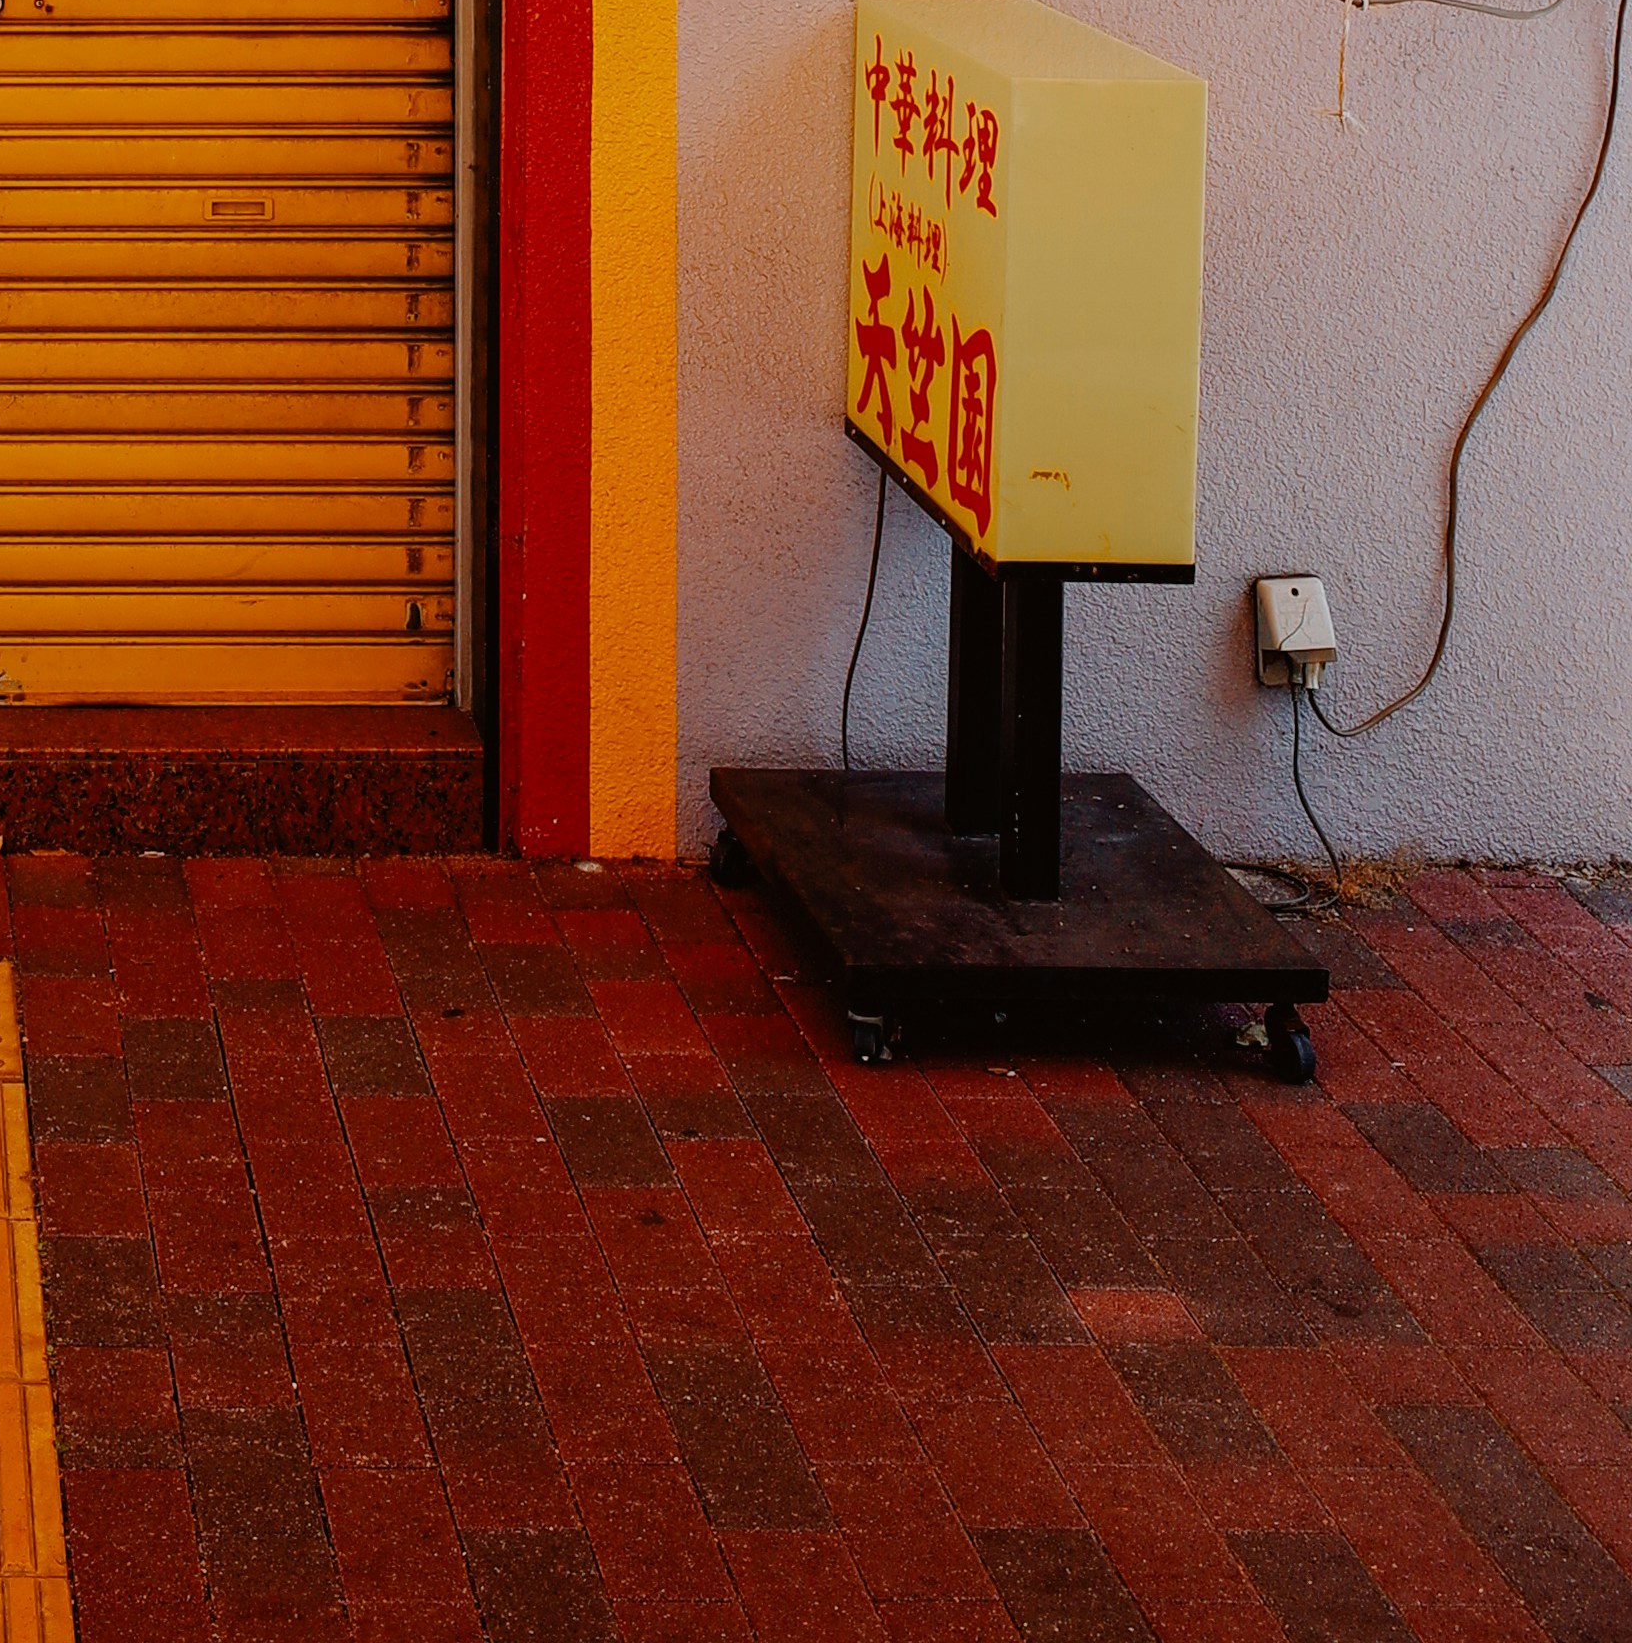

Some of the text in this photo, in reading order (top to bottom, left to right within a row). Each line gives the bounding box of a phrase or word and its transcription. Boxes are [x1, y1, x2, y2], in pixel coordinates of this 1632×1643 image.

[864, 34, 998, 217] 中華料理
[855, 253, 997, 537] 天竺園
